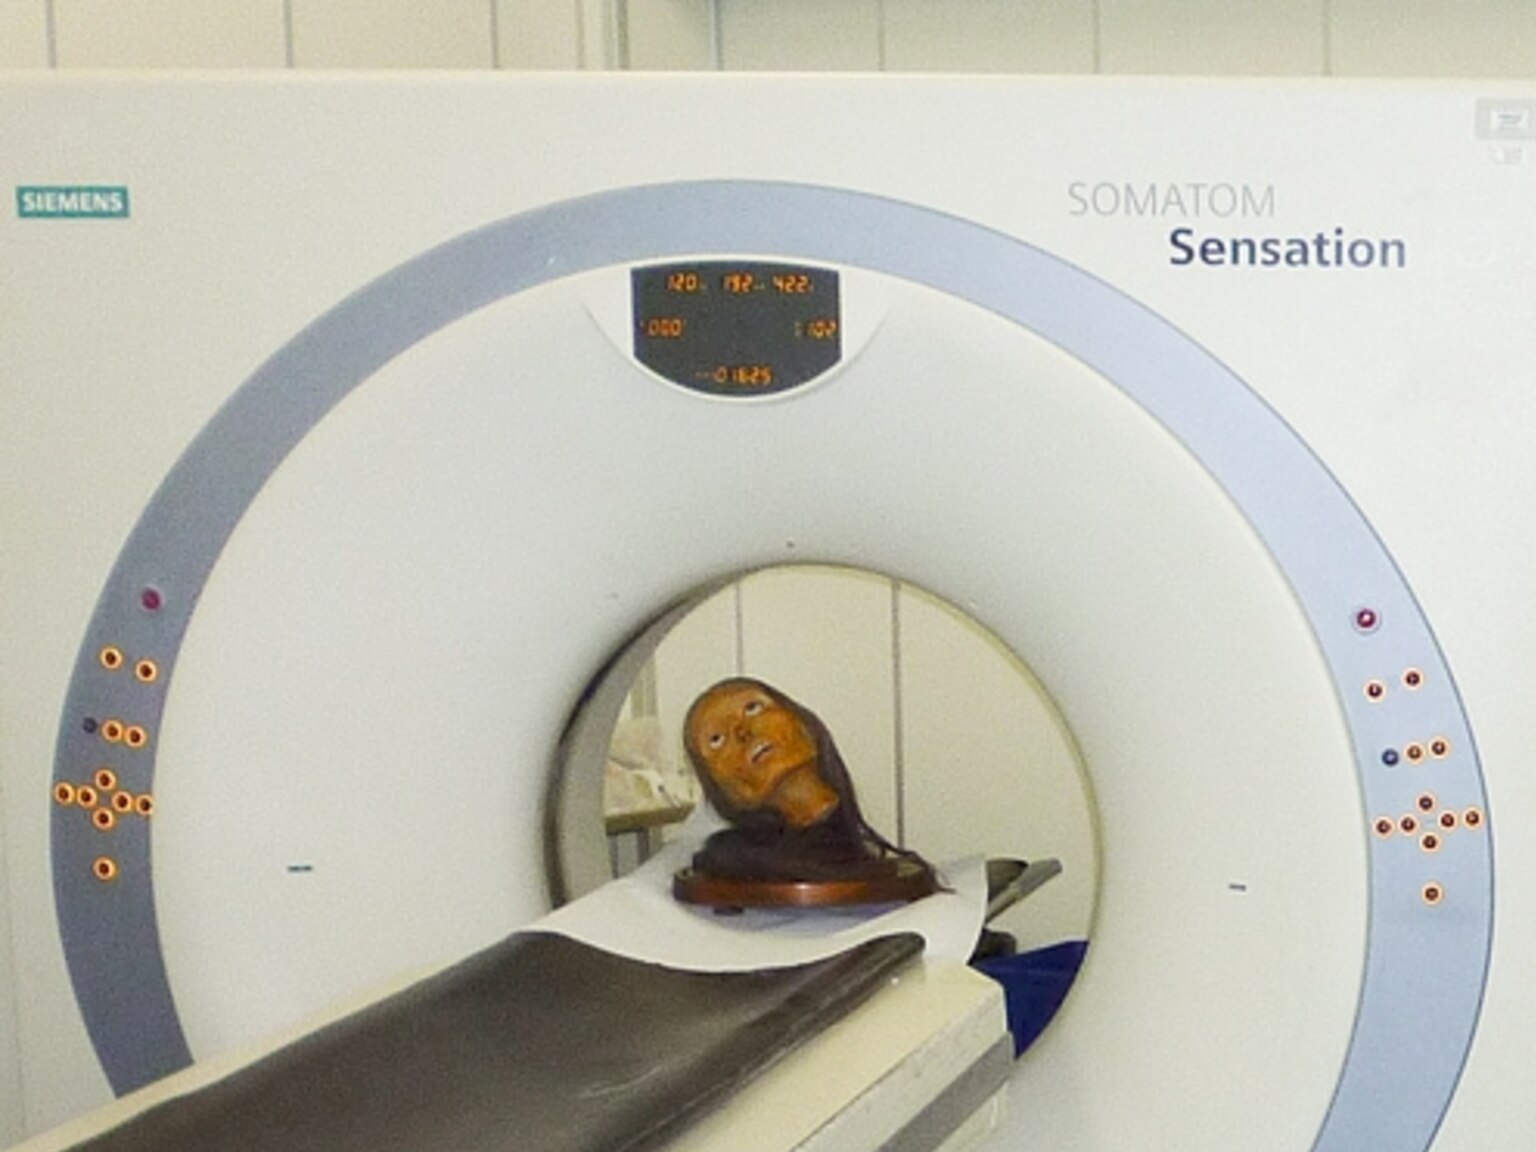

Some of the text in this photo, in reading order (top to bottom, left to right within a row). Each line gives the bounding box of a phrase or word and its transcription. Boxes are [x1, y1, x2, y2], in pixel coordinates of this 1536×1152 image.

[20, 190, 124, 213] SIEMENS
[1067, 181, 1276, 219] SOMATOM
[1169, 226, 1407, 268] Sensation
[668, 273, 697, 293] 120
[773, 275, 809, 293] 422
